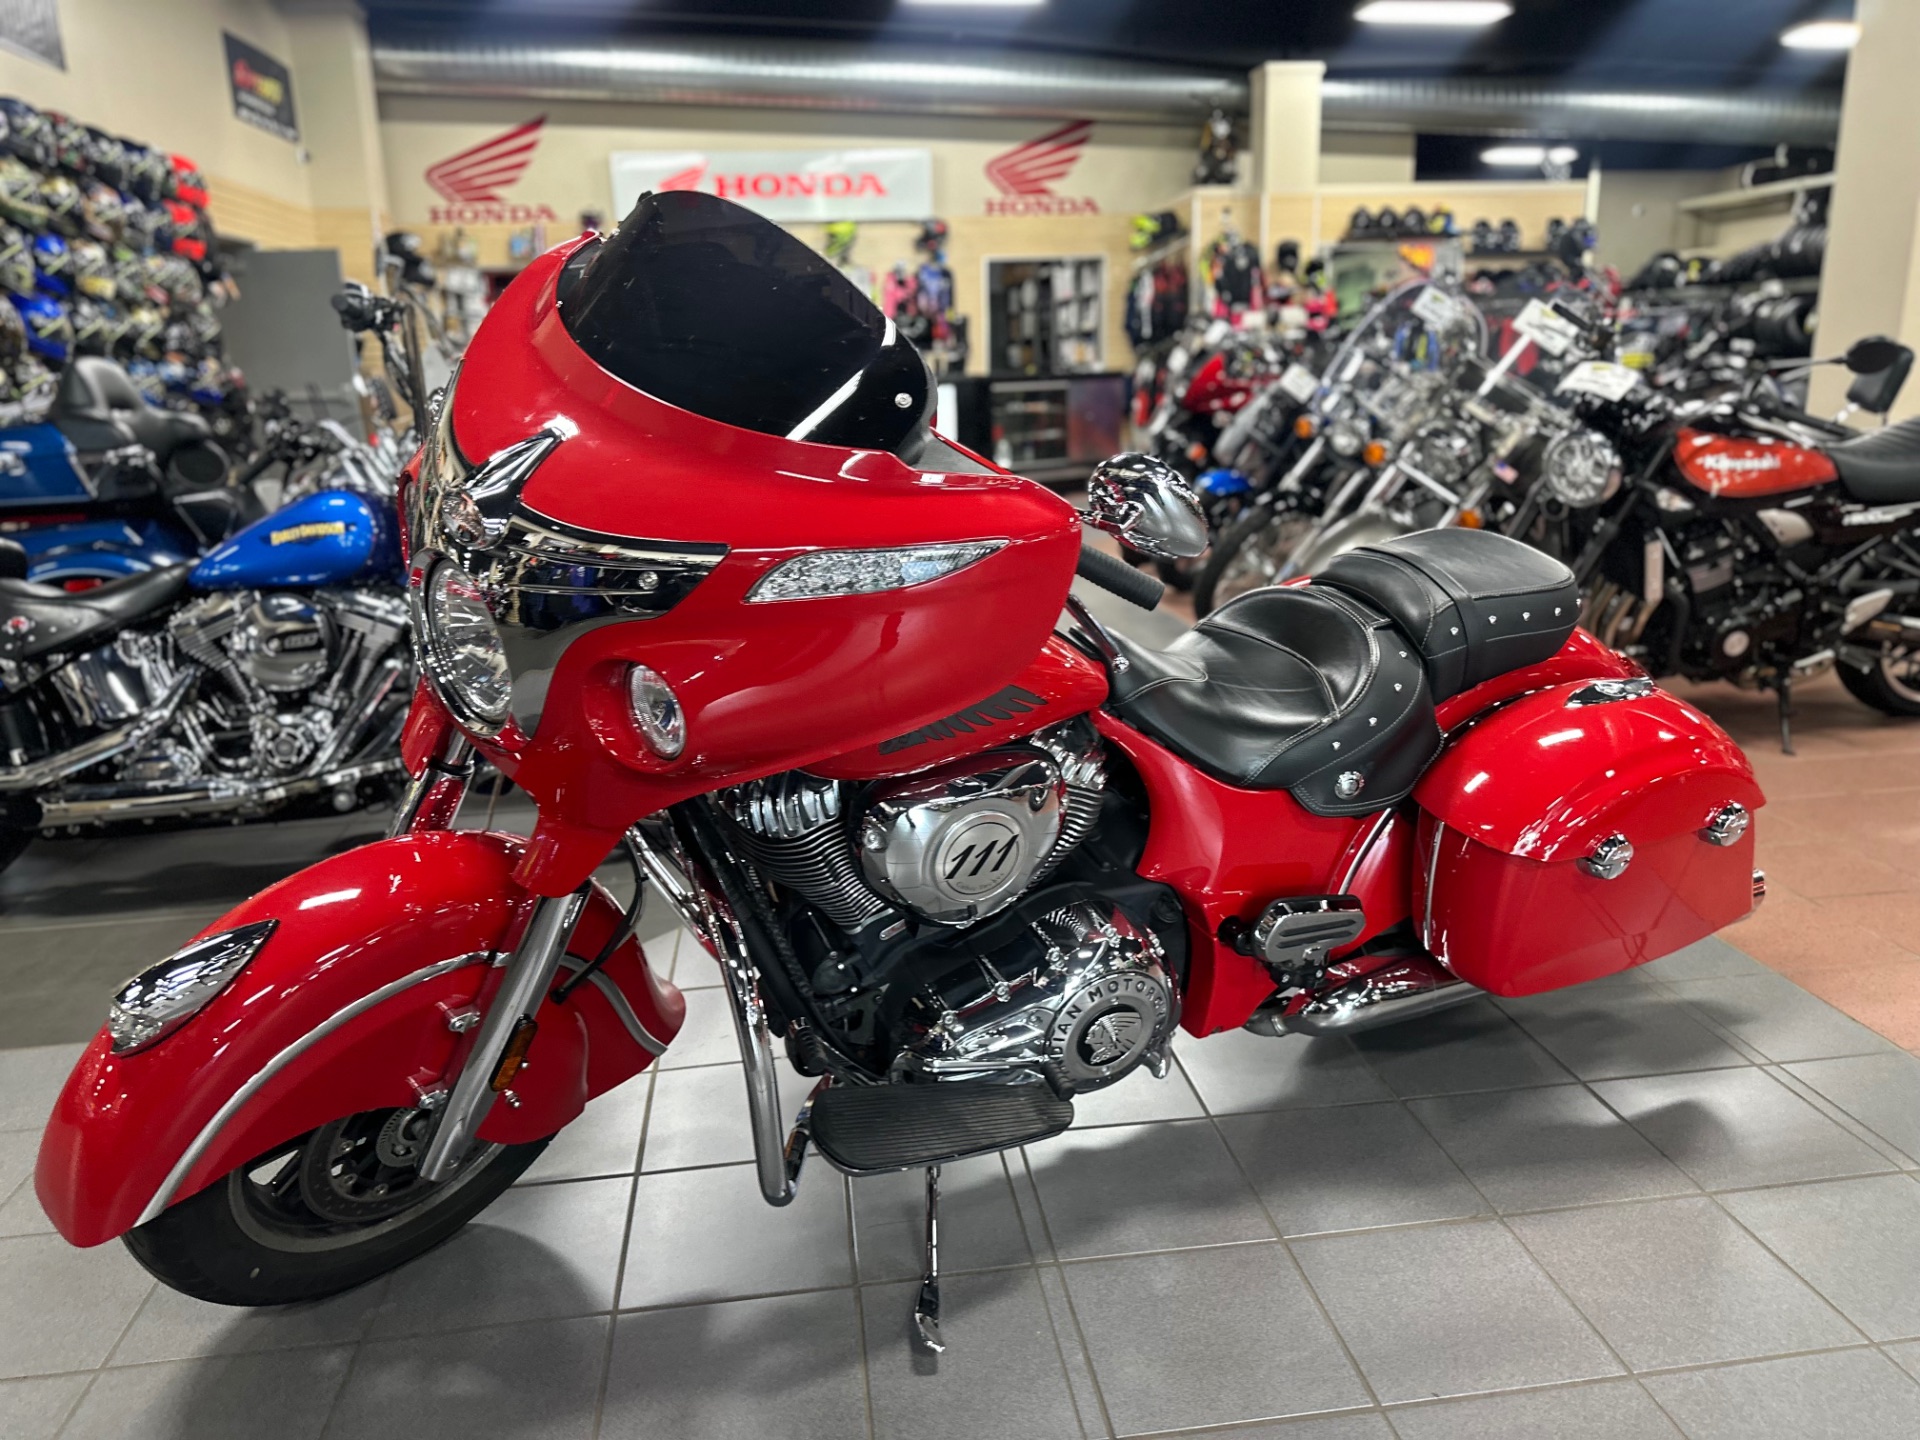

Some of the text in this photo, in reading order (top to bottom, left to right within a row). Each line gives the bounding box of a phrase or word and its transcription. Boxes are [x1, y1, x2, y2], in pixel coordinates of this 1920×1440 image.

[714, 172, 889, 199] HONDA
[429, 204, 558, 224] HONDA
[984, 196, 1101, 216] HONDA
[944, 833, 1020, 880] 111
